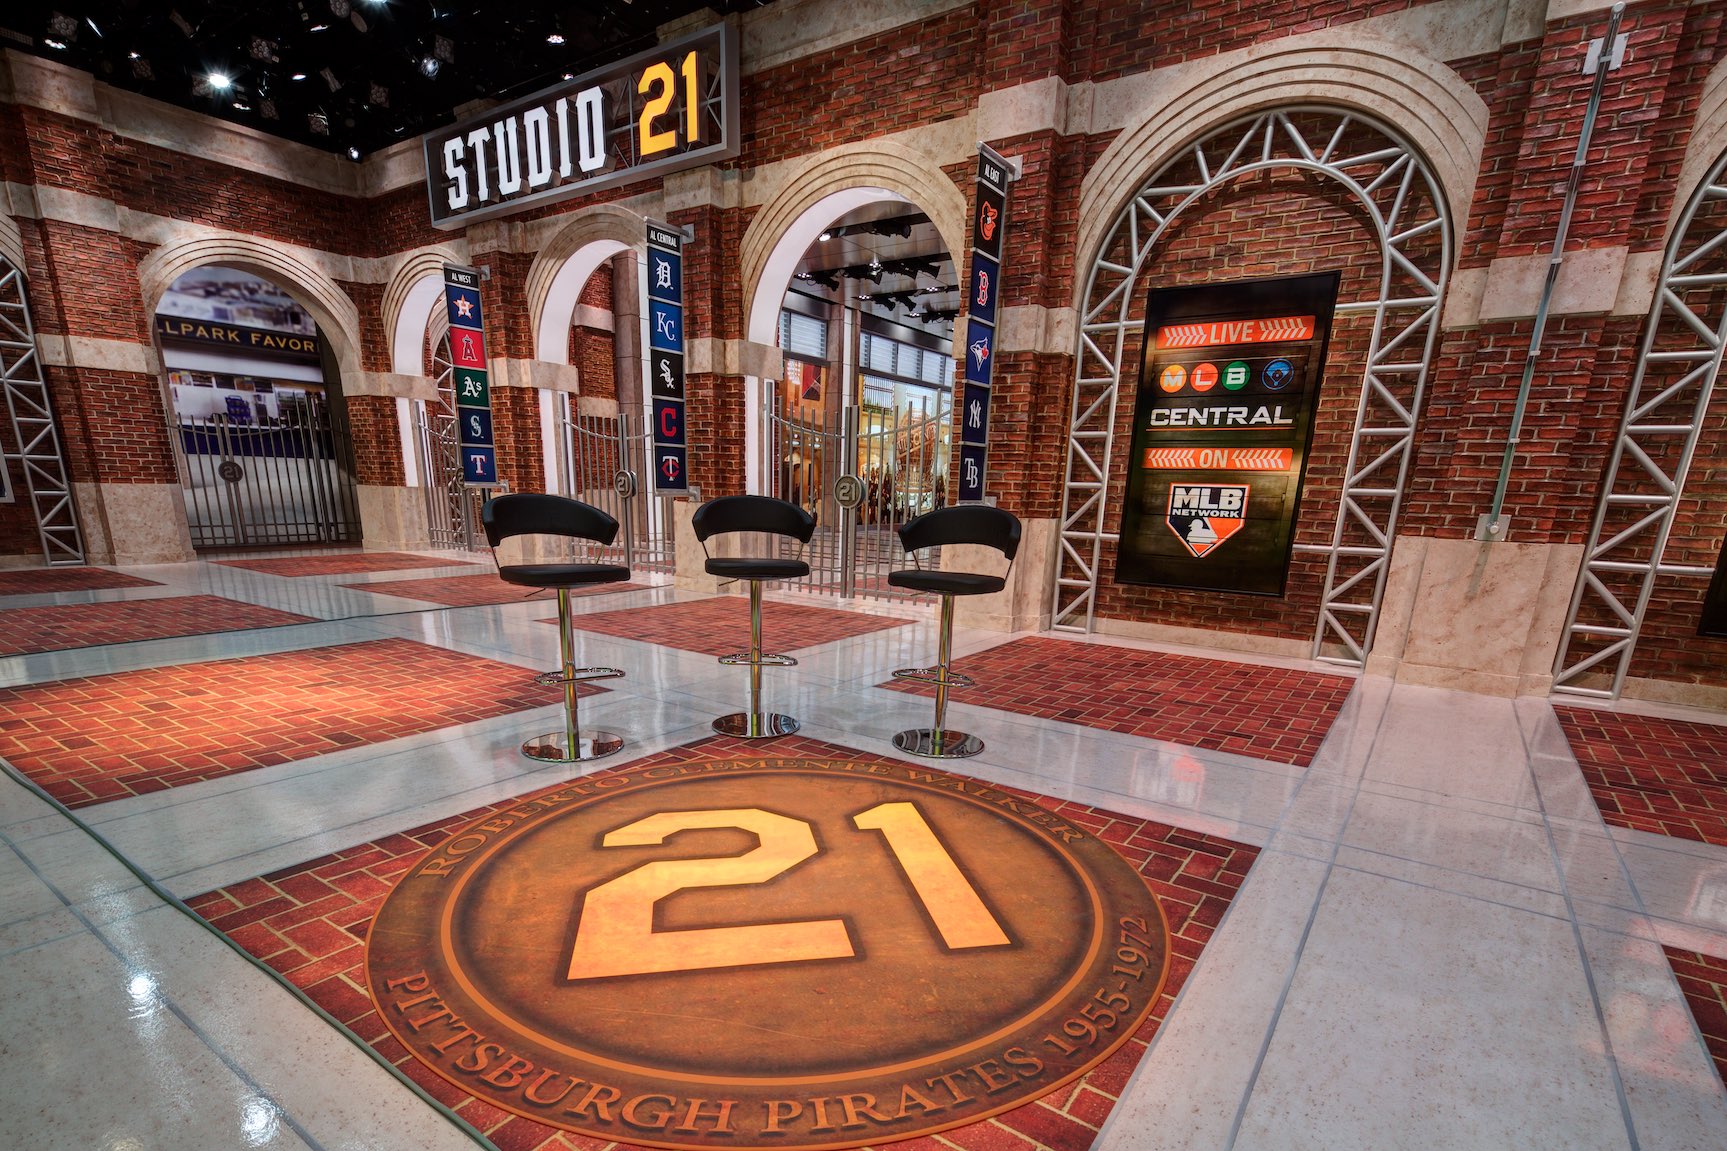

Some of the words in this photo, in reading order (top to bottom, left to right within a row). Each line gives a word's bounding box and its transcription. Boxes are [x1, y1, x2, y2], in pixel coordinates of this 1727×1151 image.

[444, 86, 606, 210] STUDIO
[637, 50, 698, 156] 21
[984, 163, 990, 178] AL
[990, 166, 1000, 184] EAST
[650, 229, 656, 241] AL
[656, 231, 677, 248] CENTRAL
[451, 272, 458, 281] AL
[458, 273, 471, 284] WEST
[159, 321, 240, 343] LPARK
[1209, 321, 1254, 344] LIVE
[661, 407, 676, 437] C
[1150, 406, 1293, 426] CENTRAL
[470, 454, 486, 475] T
[1199, 449, 1229, 469] ON
[617, 476, 629, 492] 21
[839, 482, 856, 501] 21
[1173, 488, 1243, 509] MLB
[1172, 508, 1239, 519] NETWORK
[415, 776, 631, 879] ROBERTO
[641, 759, 892, 780] CLEMENTE
[906, 769, 1086, 845] WALKER
[567, 802, 1012, 981] 21
[386, 969, 739, 1134] PITTSBURGH
[761, 1047, 1045, 1134] PIRATES
[1044, 915, 1153, 1056] 1955-1972
